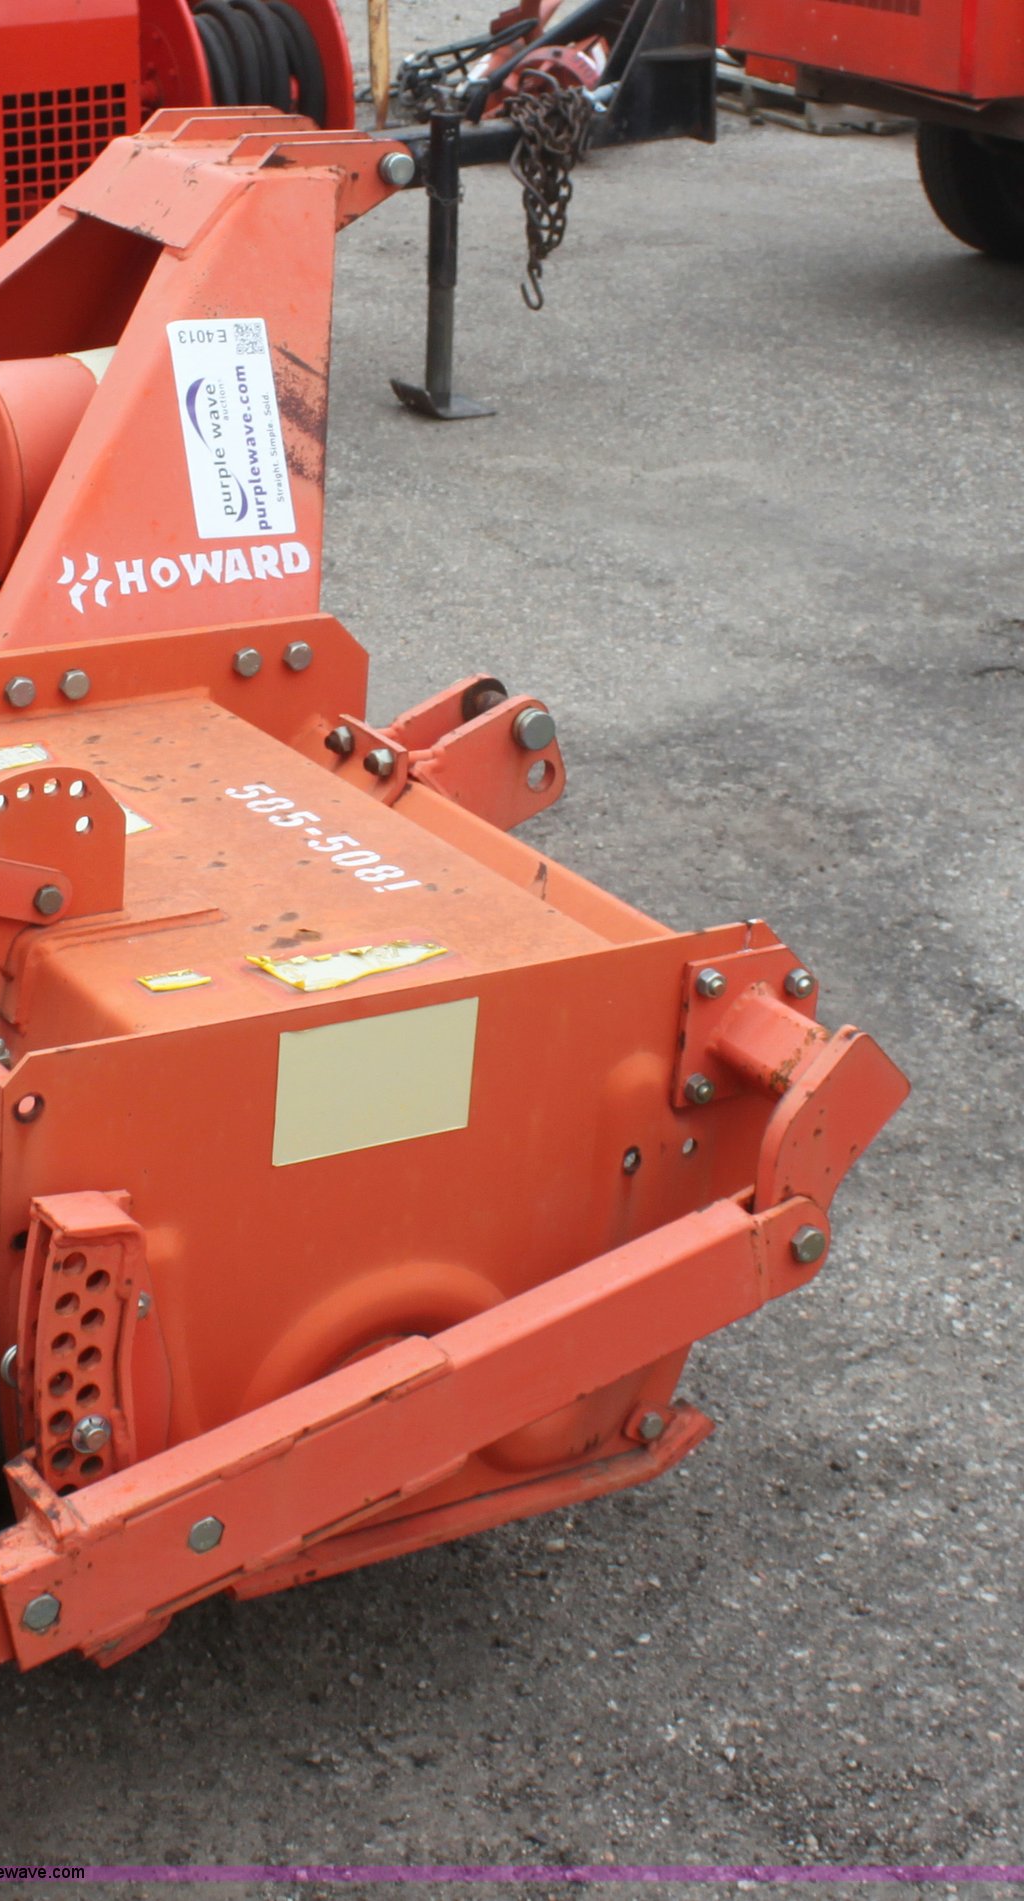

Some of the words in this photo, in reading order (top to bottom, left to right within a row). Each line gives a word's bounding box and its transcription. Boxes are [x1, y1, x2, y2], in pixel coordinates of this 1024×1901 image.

[178, 329, 226, 343] E4013
[205, 384, 223, 439] wave
[219, 382, 230, 421] auction
[263, 392, 272, 416] Sold.
[235, 365, 272, 530] purplewave.com
[268, 419, 279, 456] Simple.
[214, 447, 238, 516] purple
[274, 462, 285, 502] Straight.
[114, 541, 311, 595] HOWARD
